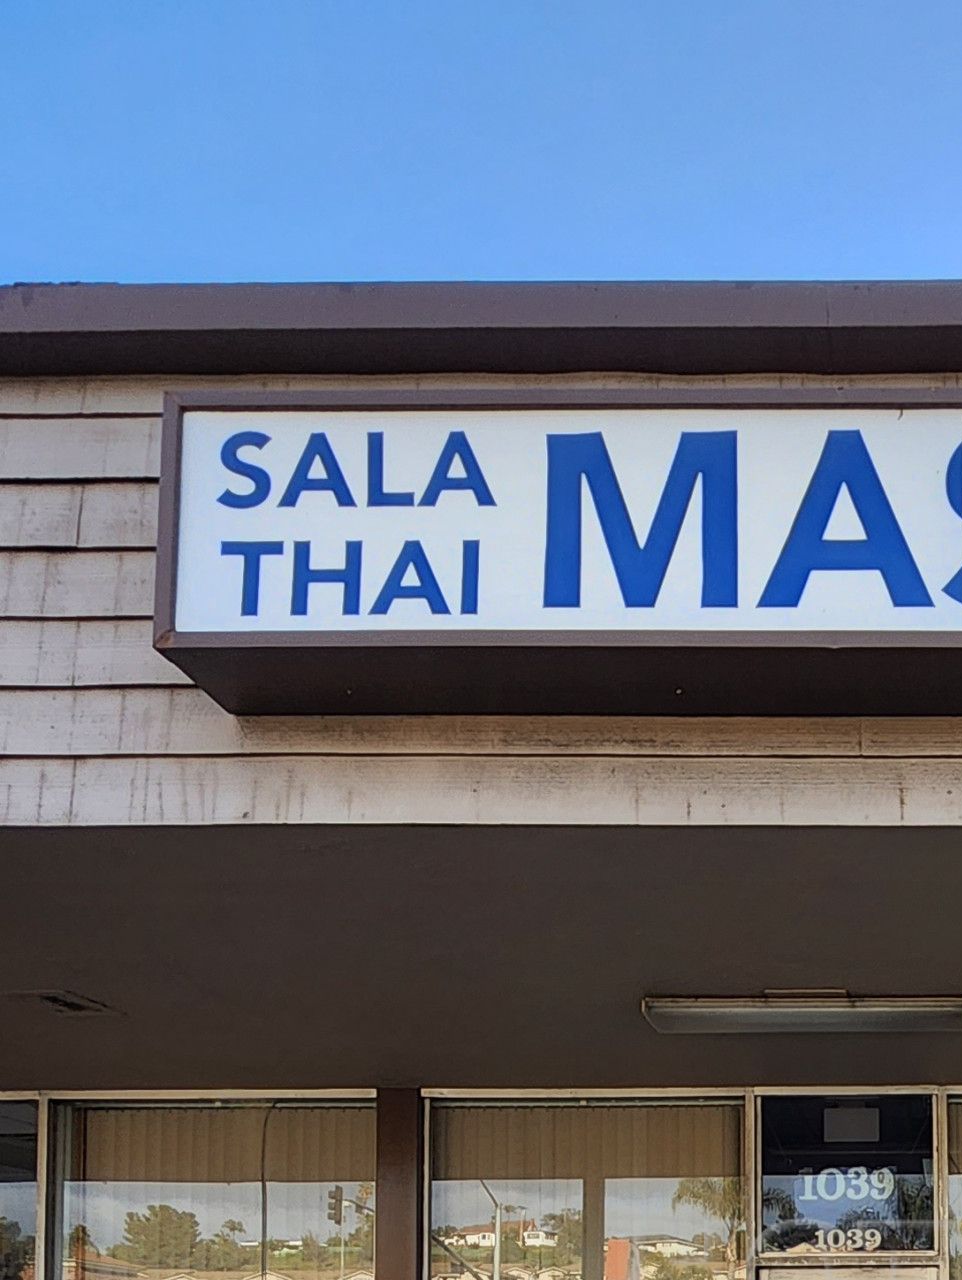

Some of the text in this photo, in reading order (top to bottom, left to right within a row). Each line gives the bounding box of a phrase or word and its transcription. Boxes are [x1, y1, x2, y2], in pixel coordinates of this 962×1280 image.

[219, 432, 493, 508] SALA
[222, 541, 478, 615] THAI
[799, 1167, 895, 1200] 1039
[814, 1228, 882, 1250] 1039
